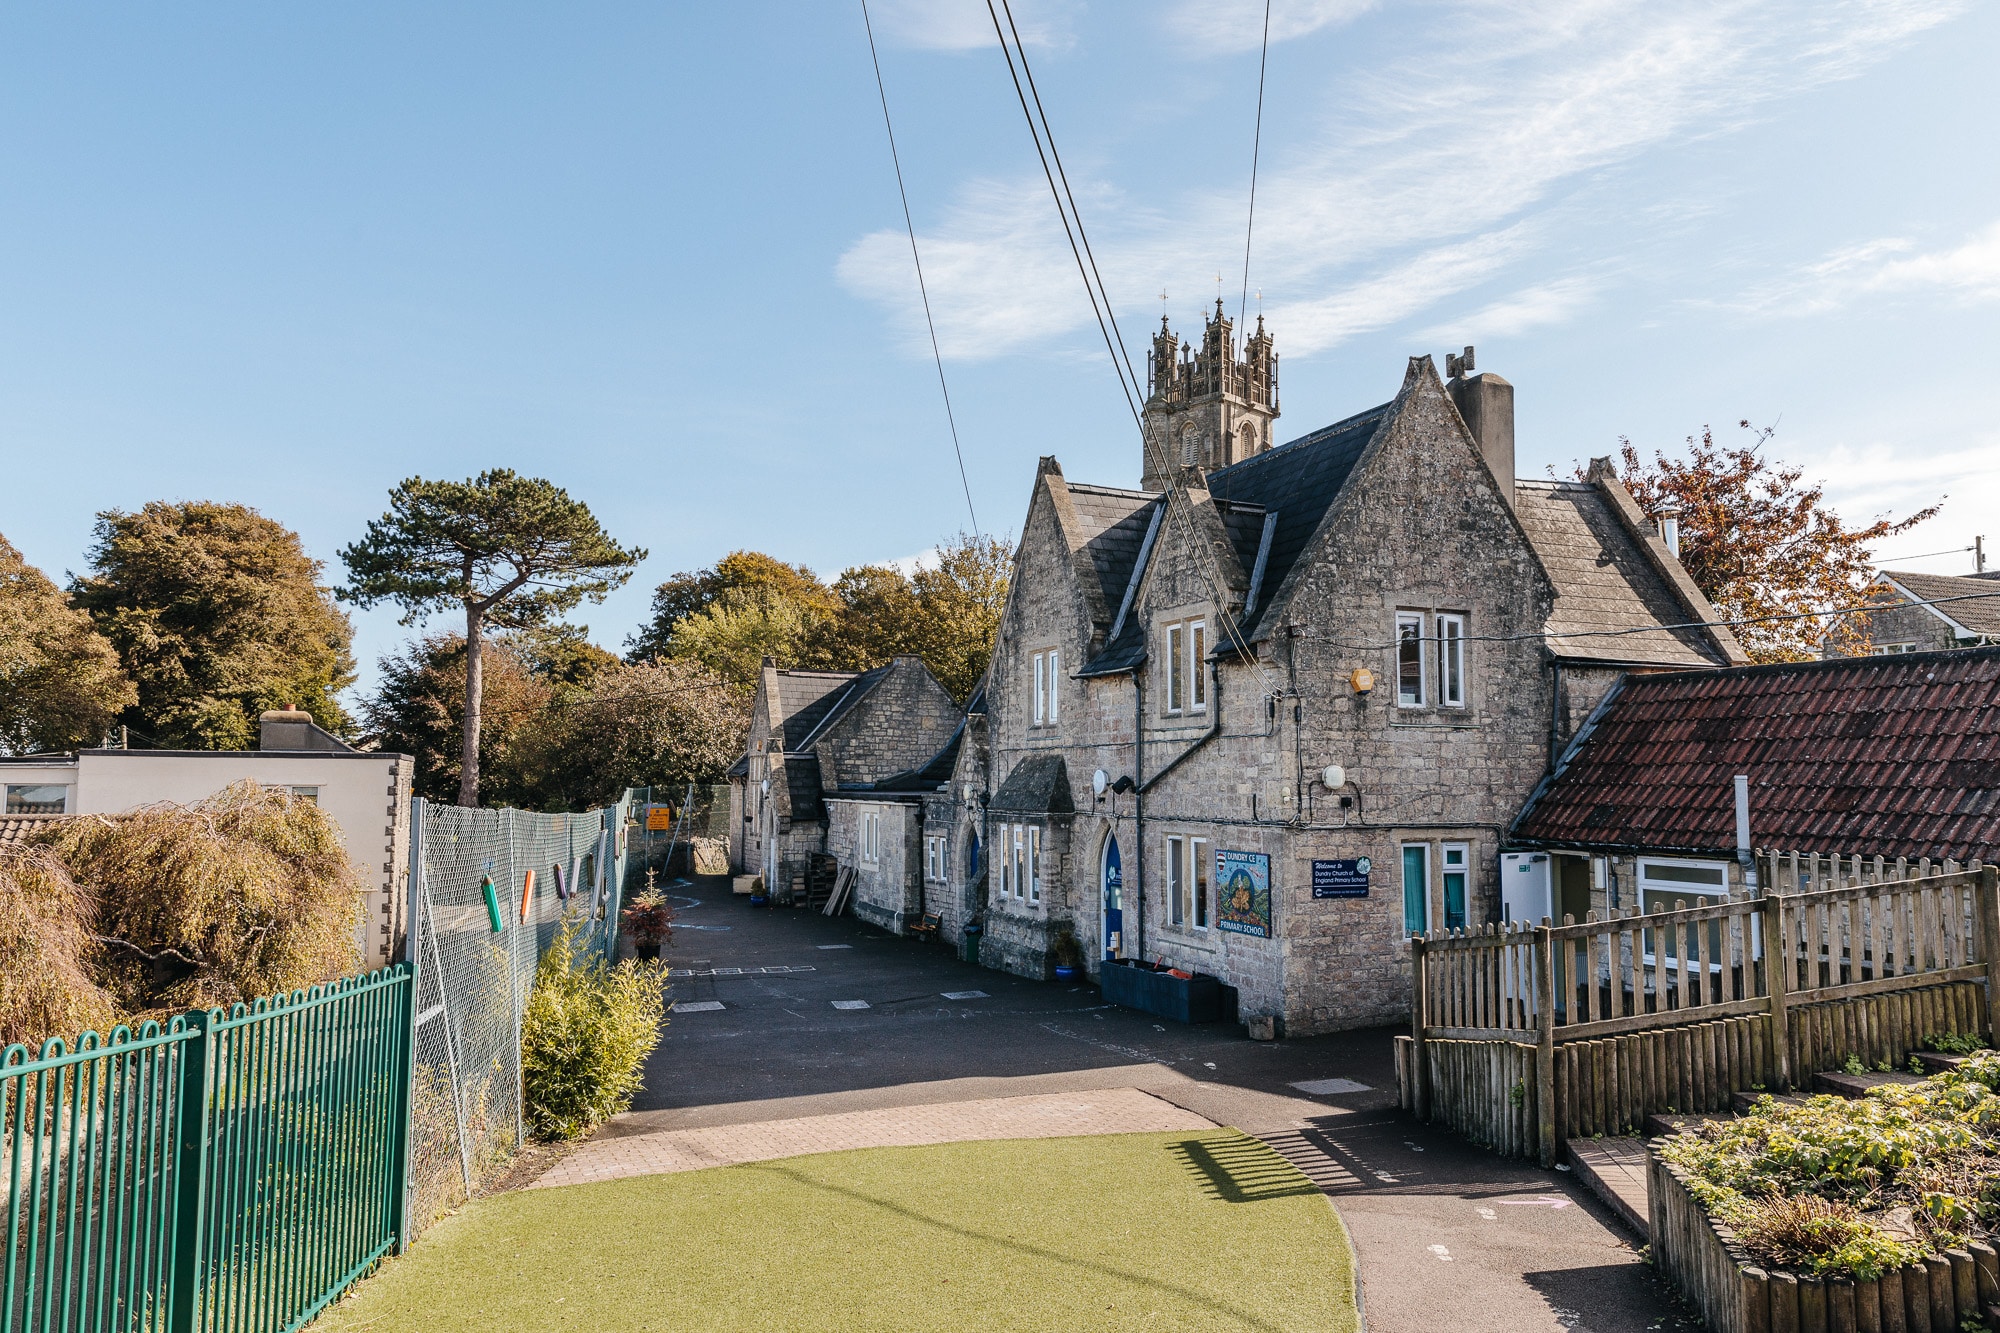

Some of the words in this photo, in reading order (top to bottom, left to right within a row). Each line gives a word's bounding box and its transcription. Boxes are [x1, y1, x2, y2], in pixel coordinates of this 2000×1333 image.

[1227, 852, 1248, 861] DUNDRY
[1249, 854, 1256, 863] CE
[1220, 920, 1243, 932] PRIMARY
[1243, 924, 1265, 936] SCHOOL
